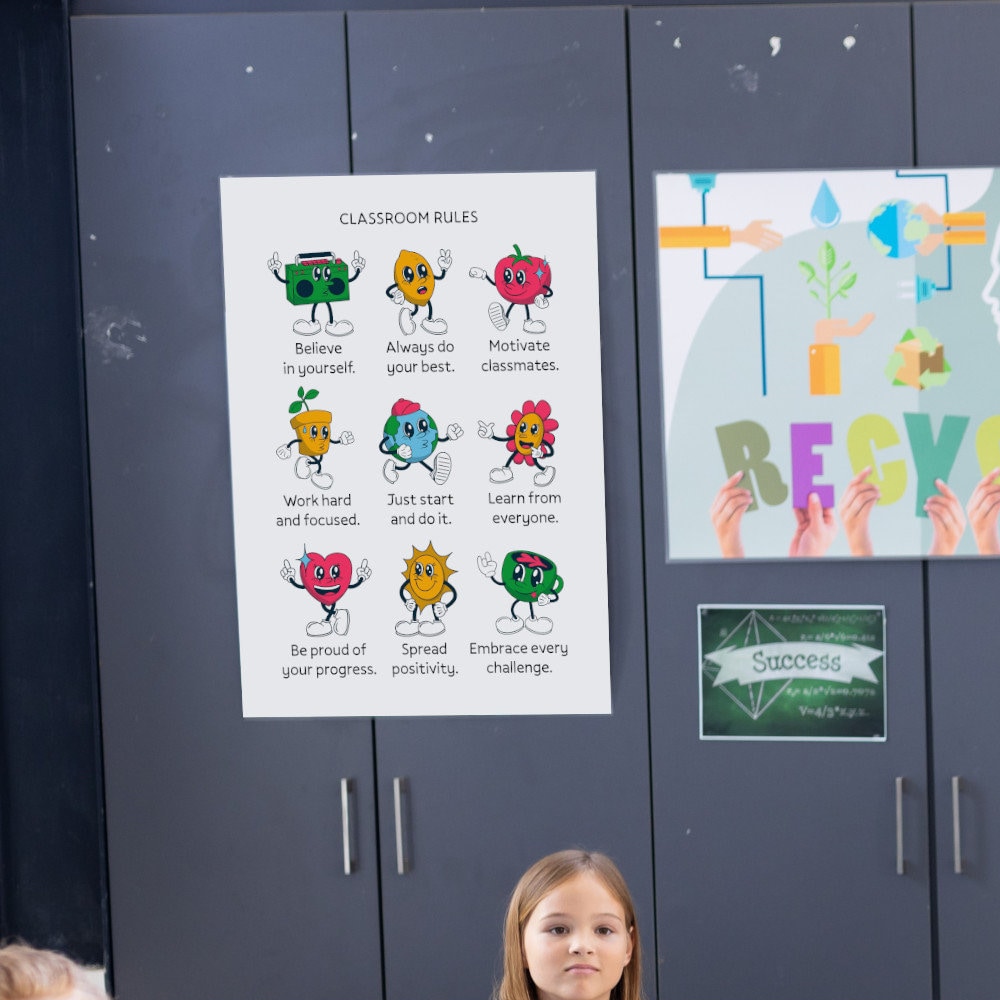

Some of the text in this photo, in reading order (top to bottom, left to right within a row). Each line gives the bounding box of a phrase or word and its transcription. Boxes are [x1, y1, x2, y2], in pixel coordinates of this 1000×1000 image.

[340, 211, 478, 225] CLASSROOM RULES
[295, 342, 343, 355] Believe
[386, 340, 455, 356] Always do
[489, 339, 550, 352] Motivate
[283, 361, 356, 377] in yourself.
[386, 360, 455, 375] your best.
[481, 359, 560, 372] classmates.
[283, 493, 352, 506] Work hard
[387, 493, 454, 506] Just start
[488, 491, 562, 505] Learn from
[276, 513, 361, 526] and focused.
[391, 512, 452, 525] and do it.
[492, 513, 559, 526] everyone.
[291, 643, 367, 660] Be proud of
[402, 642, 447, 658] Spread
[470, 642, 568, 657] Embrace every
[486, 660, 553, 676] challenge.
[752, 650, 842, 673] Success
[282, 665, 377, 679] your progress.
[392, 661, 459, 678] positivity.
